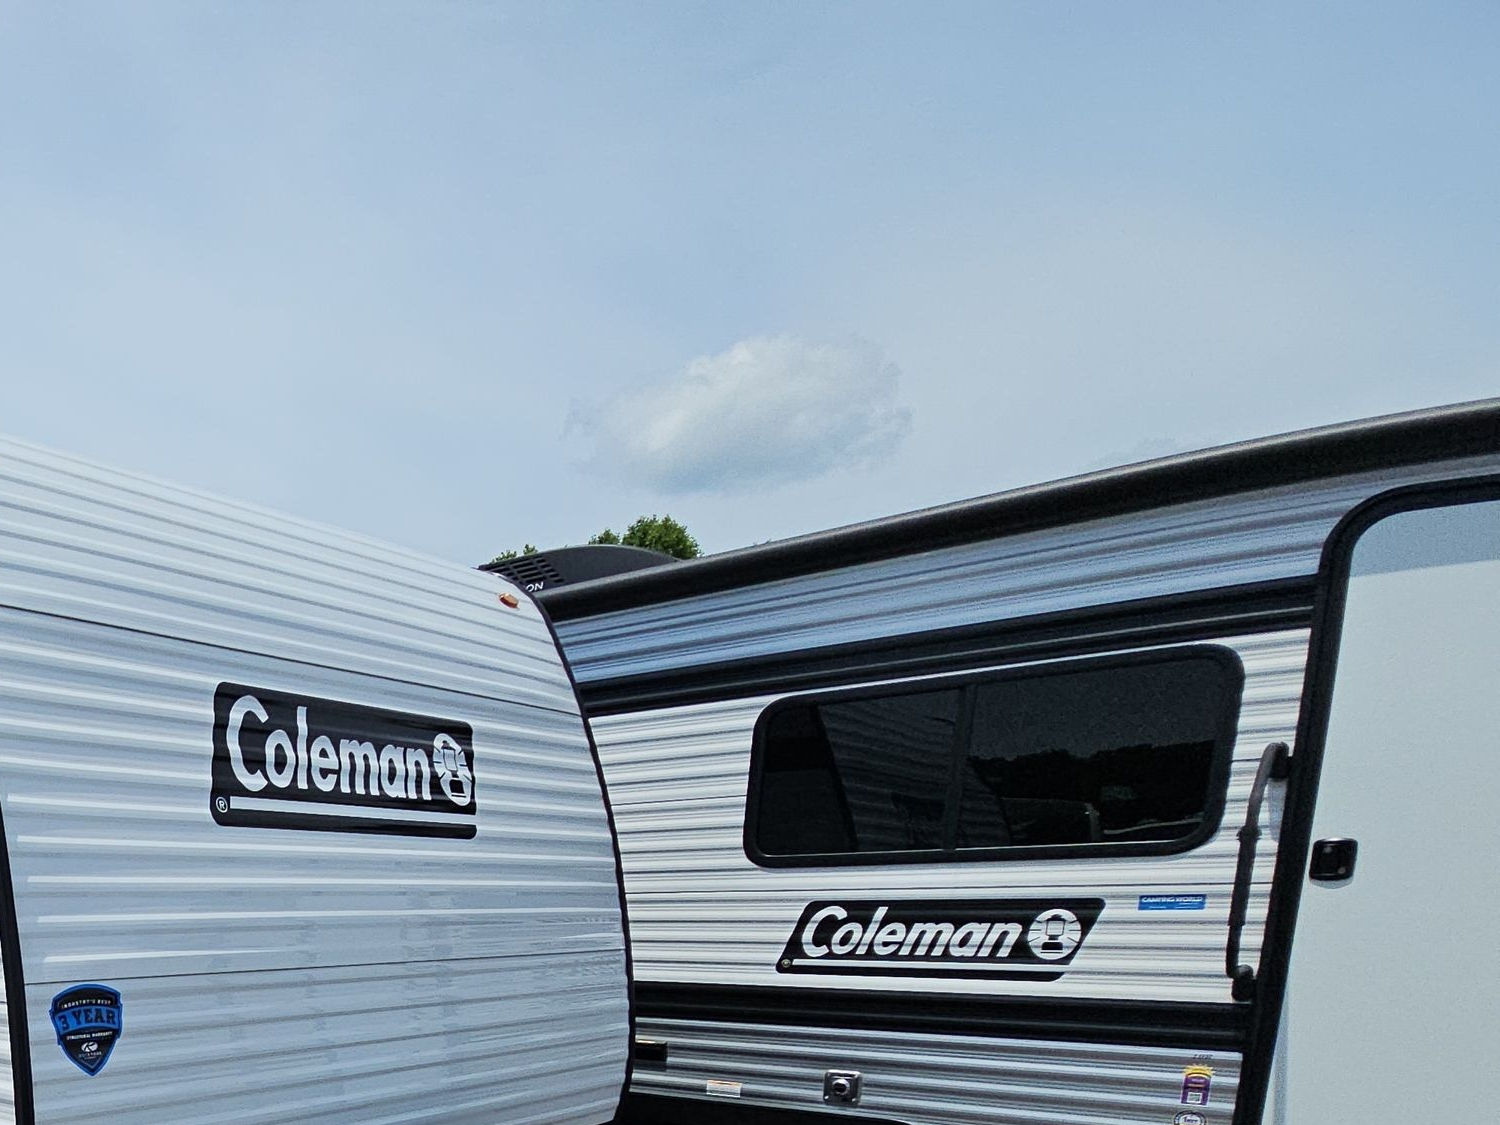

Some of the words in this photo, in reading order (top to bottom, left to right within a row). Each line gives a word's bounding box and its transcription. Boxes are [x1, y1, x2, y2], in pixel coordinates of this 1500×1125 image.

[226, 694, 432, 801] Coleman
[801, 905, 1023, 958] Coleman
[58, 1014, 69, 1031] 3
[71, 1008, 116, 1026] YEAR
